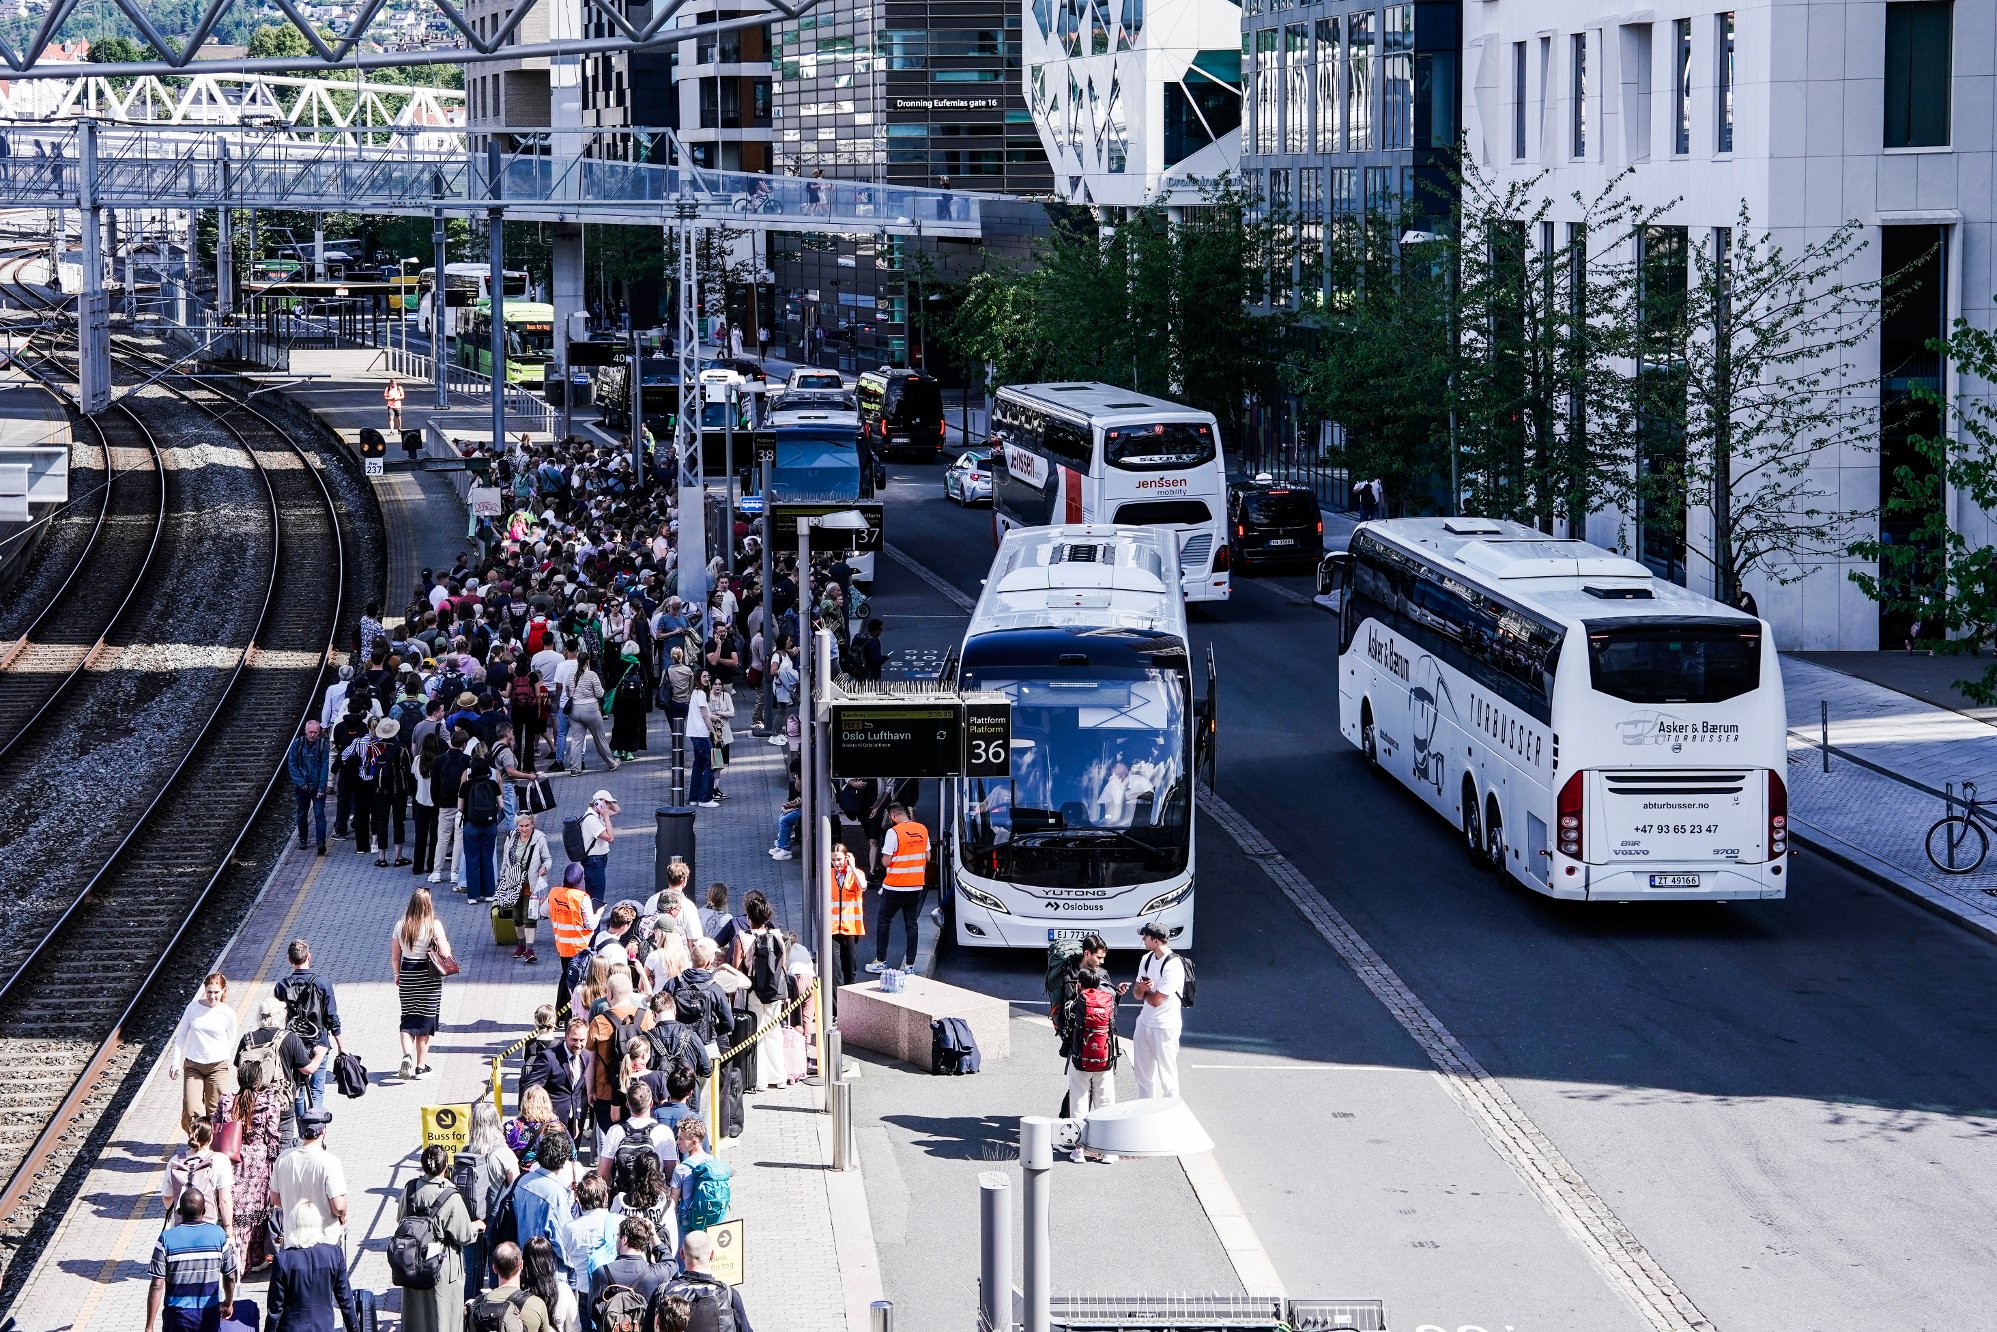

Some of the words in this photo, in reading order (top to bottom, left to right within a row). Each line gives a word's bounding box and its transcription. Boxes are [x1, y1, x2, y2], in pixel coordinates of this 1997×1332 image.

[896, 99, 932, 109] Dronning
[934, 99, 968, 107] Eufemias
[969, 100, 986, 108] gate
[988, 99, 997, 107] 16
[613, 354, 626, 363] 40
[758, 449, 774, 462] 38
[366, 465, 382, 474] 237
[1157, 488, 1187, 496] mobility
[858, 528, 880, 543] 37
[1367, 625, 1384, 667] Asker
[970, 716, 1006, 724] Plattform
[1470, 693, 1541, 768] TURBUSSER
[1658, 721, 1690, 733] Asker
[1691, 723, 1699, 733] &
[1702, 721, 1739, 733] Bærum
[842, 731, 865, 741] Oslo
[867, 730, 911, 741] Lufthavn
[1666, 734, 1739, 742] TURBUSSER
[971, 740, 1005, 764] 36
[1643, 801, 1709, 810] abturbusser.no
[1634, 824, 1654, 834] +47
[1657, 824, 1670, 834] 93
[1673, 824, 1687, 834] 65
[1690, 824, 1702, 834] 23
[1706, 824, 1719, 834] 47
[1658, 876, 1668, 885] ZT
[1671, 876, 1697, 885] 49166
[1042, 889, 1107, 897] YUTONG
[1062, 902, 1104, 911] Oslobuss
[1057, 930, 1067, 939] EJ
[427, 1132, 450, 1141] Buss
[451, 1130, 466, 1140] for
